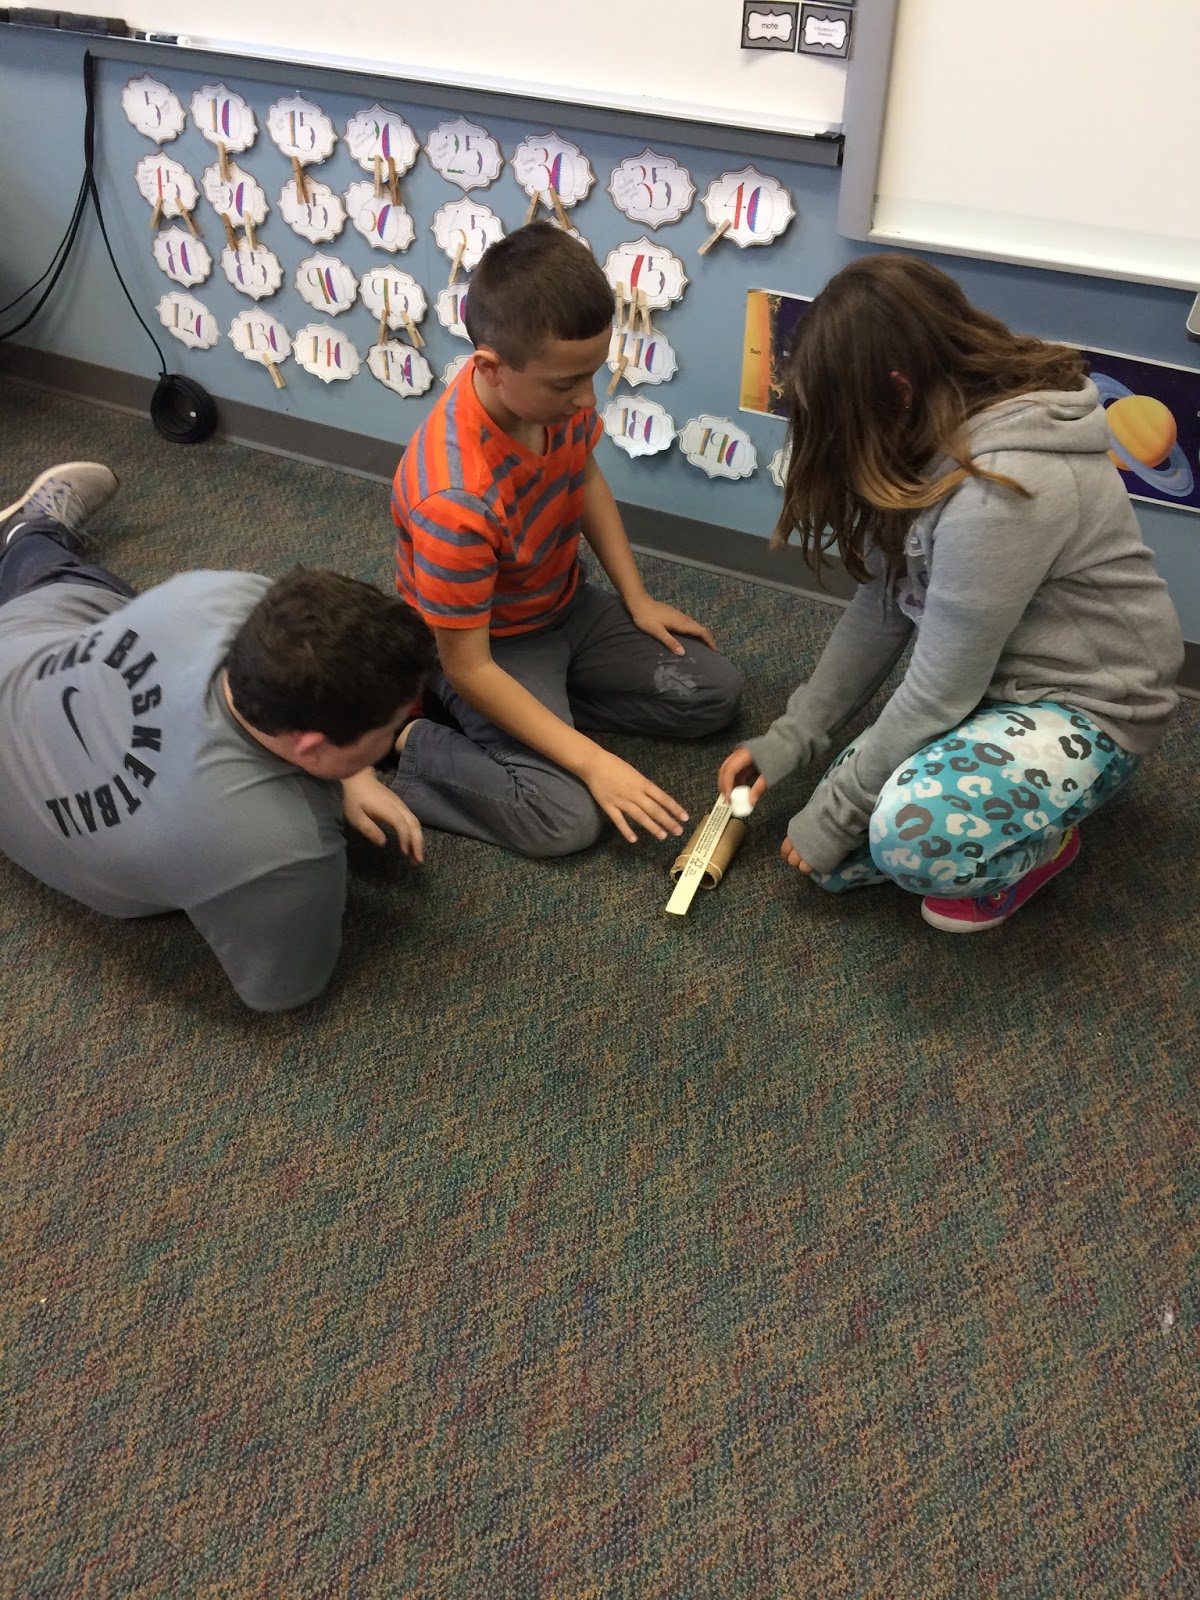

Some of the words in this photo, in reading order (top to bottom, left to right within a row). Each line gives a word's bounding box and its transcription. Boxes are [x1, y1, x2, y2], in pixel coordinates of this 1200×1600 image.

[144, 91, 162, 128] 5
[208, 98, 241, 140] 10
[285, 110, 316, 151] 15
[365, 119, 403, 164] 20
[445, 133, 483, 176] 25
[532, 148, 575, 197] 30
[150, 166, 181, 202] 45
[631, 165, 672, 211] 35
[359, 195, 400, 243] 60
[724, 182, 774, 234] 40
[449, 210, 487, 254] 65
[166, 240, 200, 276] 80
[235, 250, 268, 287] 85
[625, 253, 666, 297] 75
[307, 267, 344, 304] 90
[371, 276, 409, 317] 95
[171, 303, 207, 340] 120
[244, 322, 283, 353] 130
[309, 335, 347, 369] 140
[616, 333, 664, 375] 110
[618, 407, 661, 445] 180
[699, 427, 746, 468] 190
[46, 628, 162, 838] BASKETBALL
